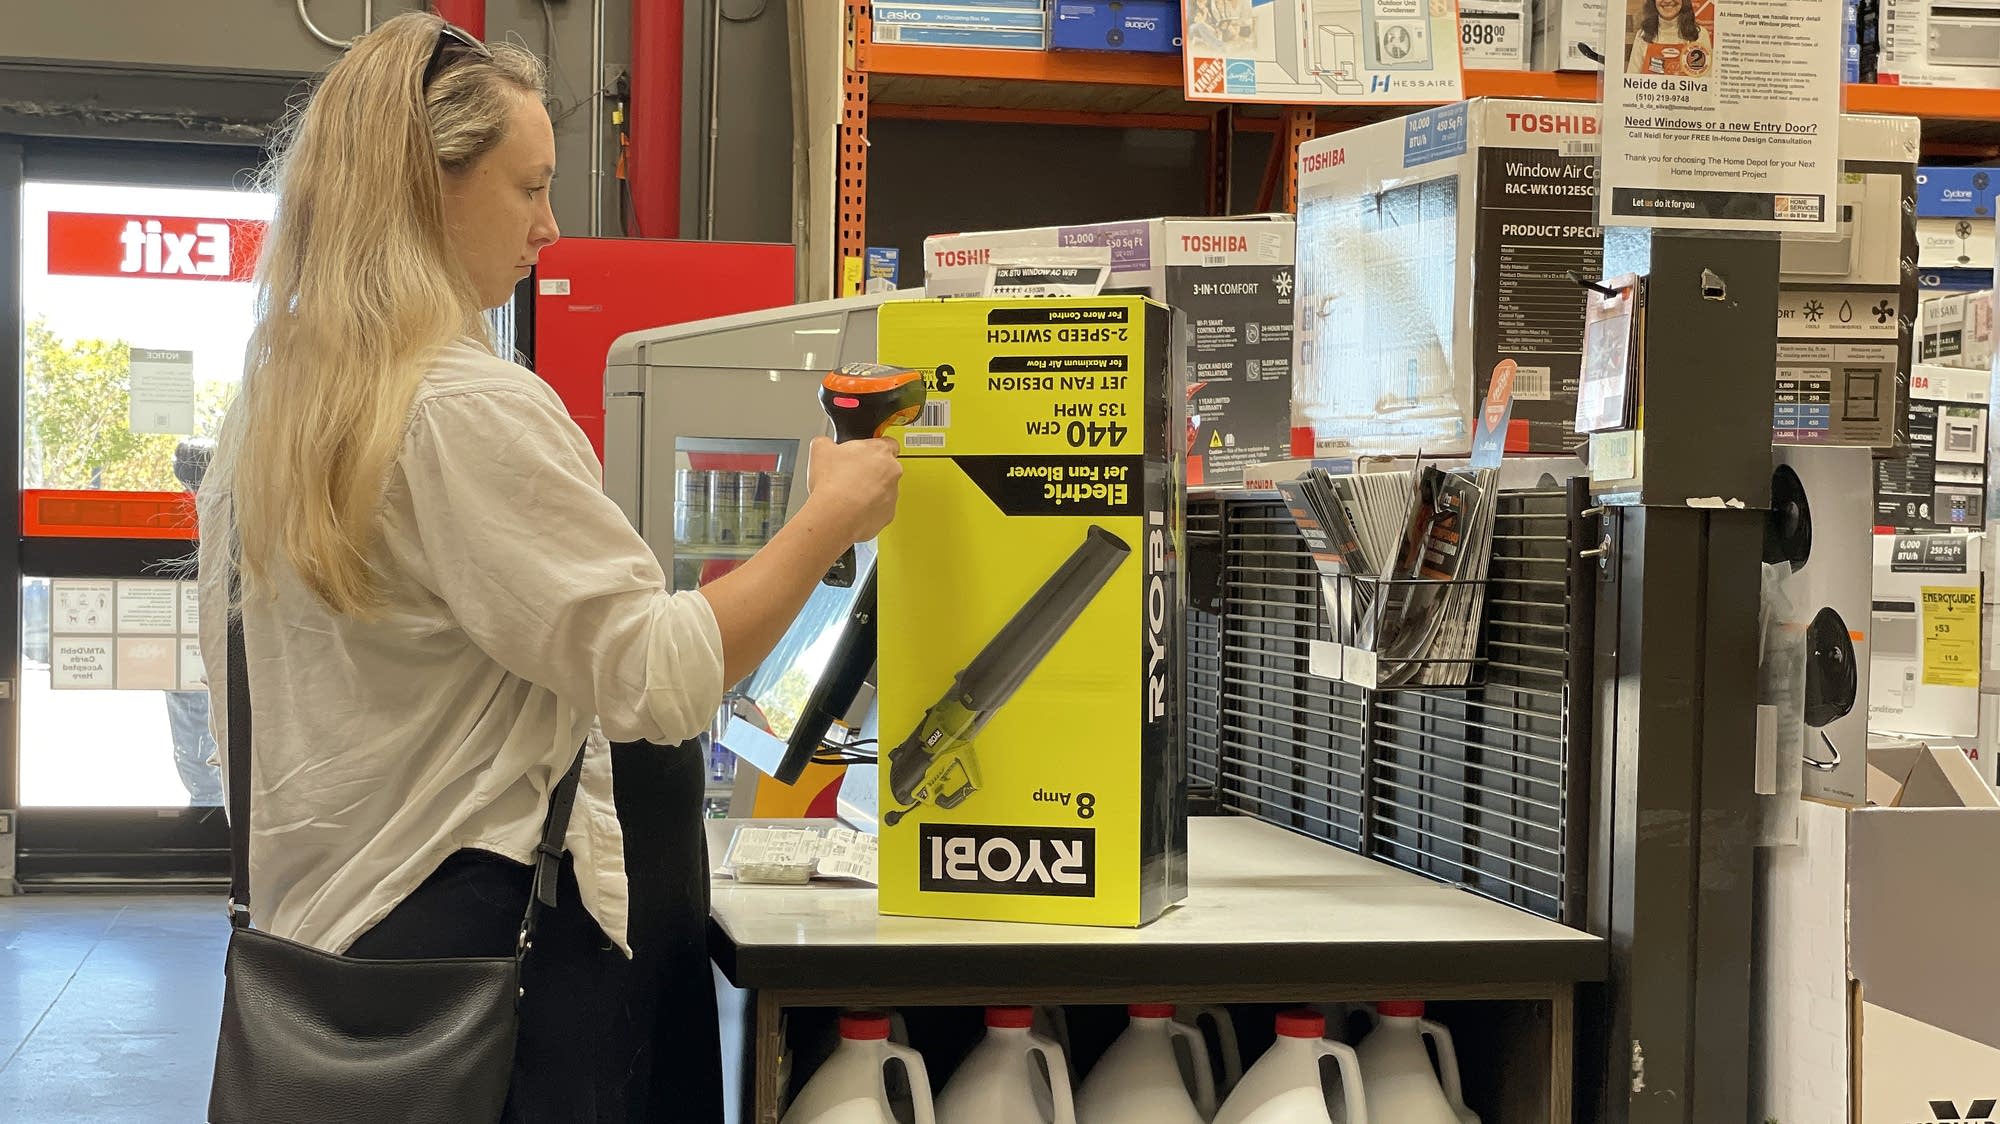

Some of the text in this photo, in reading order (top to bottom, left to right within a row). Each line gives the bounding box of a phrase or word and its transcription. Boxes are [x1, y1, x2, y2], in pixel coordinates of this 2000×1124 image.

[878, 9, 921, 22] Lasko
[1125, 21, 1156, 31] Cyclone
[1624, 78, 1708, 92] Neide da Silva
[1636, 94, 1654, 102] (510)
[1409, 116, 1430, 132] 10,000
[1625, 116, 1652, 126] Need
[1655, 117, 1702, 128] Windows
[1754, 122, 1781, 133] Entry
[1785, 123, 1817, 132] Door?
[1409, 134, 1426, 148] BTU/h
[1302, 148, 1345, 174] TOSHIBA
[1674, 156, 1705, 165] choosing
[1746, 158, 1768, 167] Depot
[1506, 162, 1582, 178] Window Air
[1694, 169, 1740, 178] Improvement
[1742, 170, 1767, 179] Project
[1944, 190, 1972, 199] Cyclone
[1632, 198, 1644, 207] Let
[1654, 200, 1663, 208] do
[1665, 200, 1670, 208] it
[1671, 200, 1681, 208] for
[1682, 201, 1695, 209] you
[1502, 224, 1560, 237] PRODUCT
[1064, 233, 1094, 244] 12,000
[1122, 238, 1133, 249] Sq
[1134, 237, 1143, 246] Ft
[1181, 235, 1248, 252] TOSHIBA
[1927, 237, 1954, 246] Cyclone
[1193, 283, 1258, 295] 3-IN-1 COMFORT
[1049, 311, 1122, 320] For More Control
[987, 328, 1128, 344] 2-SPEED SWITCH
[1026, 359, 1122, 368] for Maximum Air Flow
[935, 364, 956, 392] 3
[988, 376, 1128, 391] JET FAN DESIGN
[1054, 403, 1127, 416] 135 MPH
[1026, 420, 1128, 448] 440 CFM
[1006, 466, 1128, 480] Jet Fan Blower
[1044, 483, 1128, 505] Electric
[1900, 540, 1920, 549] 6,000
[1898, 552, 1918, 560] BTU/h
[1944, 547, 1952, 556] Sq
[1923, 593, 1976, 604] ENERGYGUIDE
[1148, 510, 1165, 723] RYOBI
[926, 728, 942, 748] RYOBI
[1032, 791, 1095, 819] 8 Amp
[932, 836, 1087, 885] RYOBI
